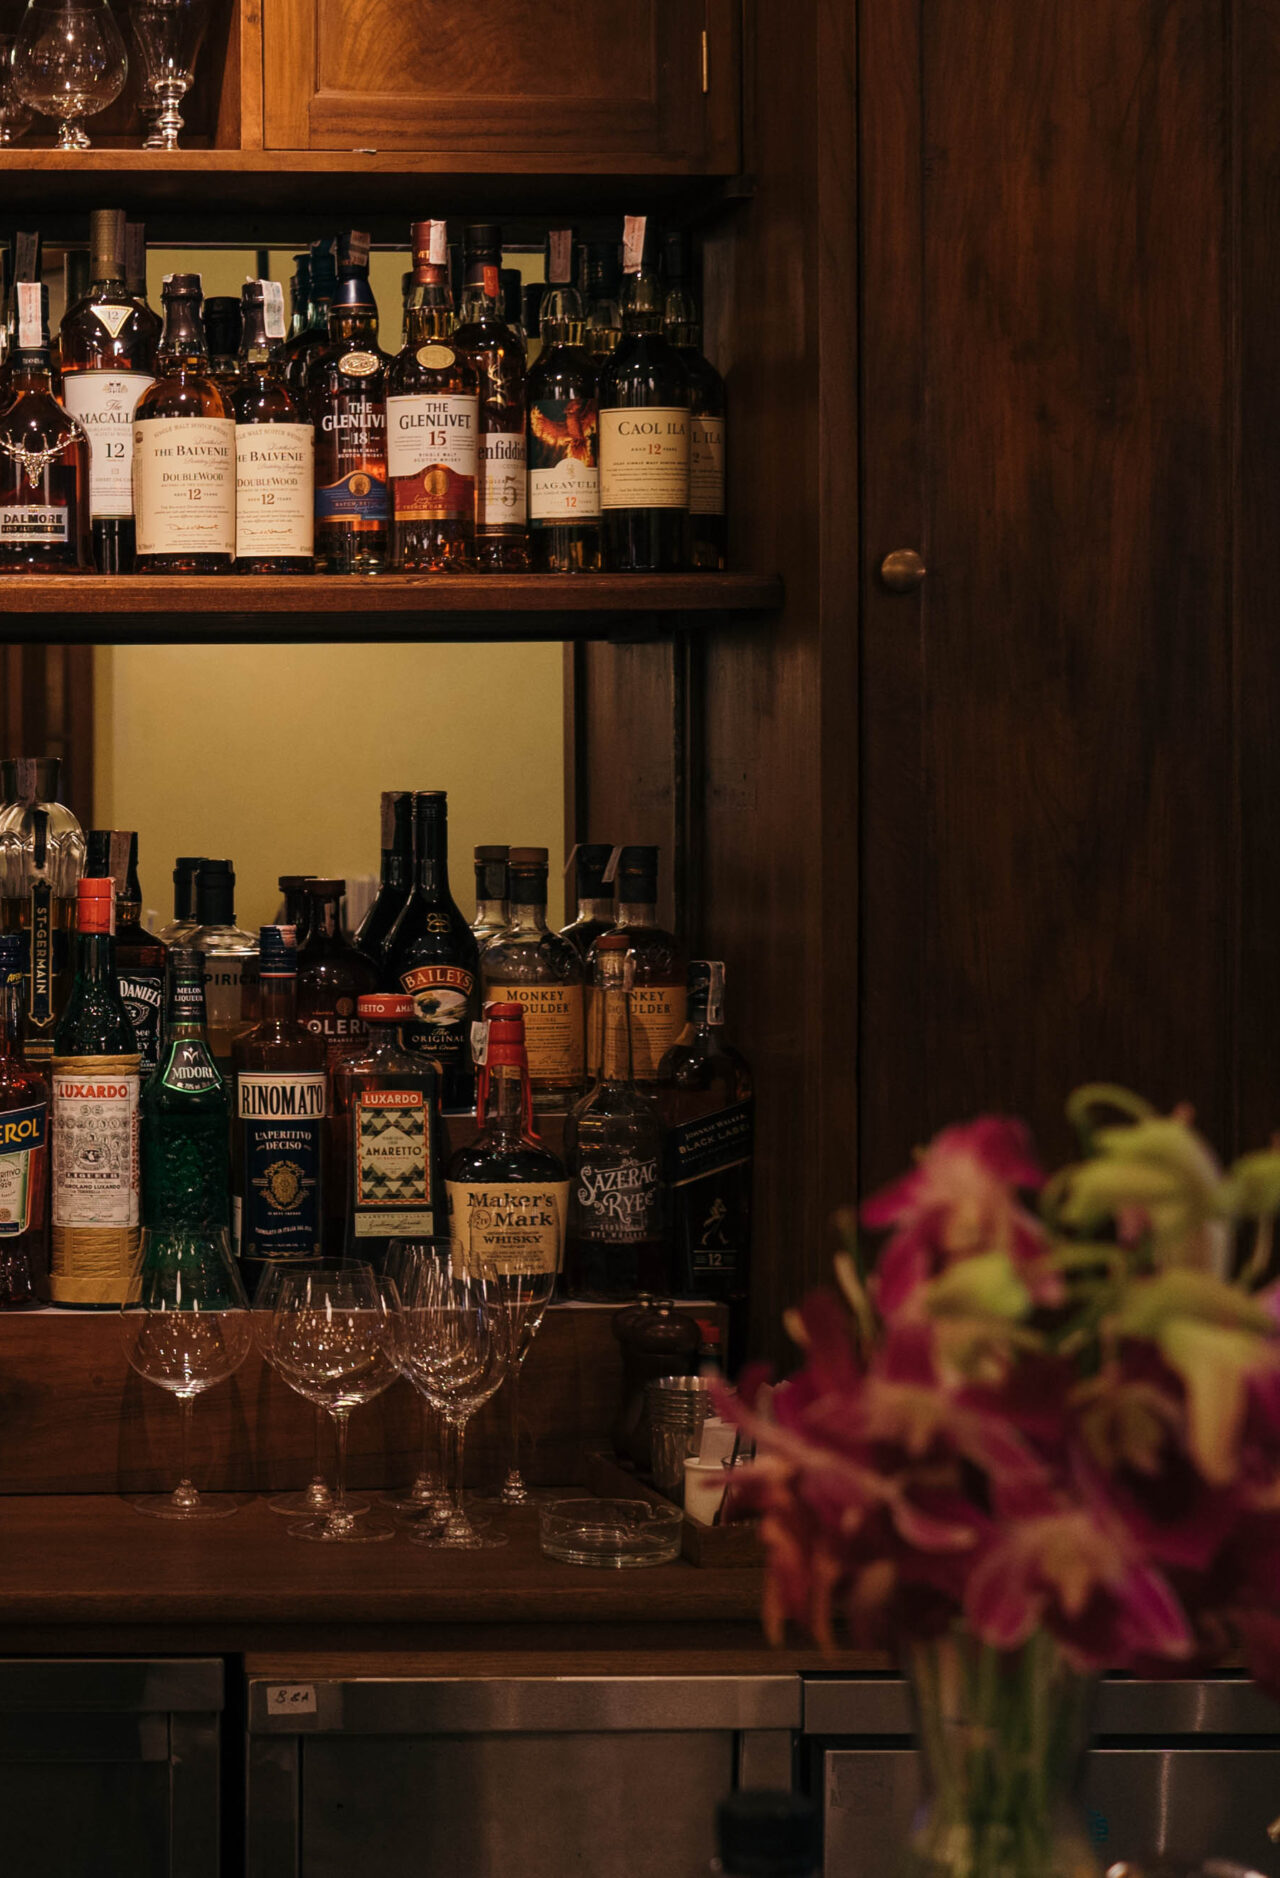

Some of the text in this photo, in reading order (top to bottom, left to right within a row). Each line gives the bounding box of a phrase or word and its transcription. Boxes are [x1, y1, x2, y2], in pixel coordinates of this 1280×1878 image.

[348, 402, 373, 414] THE
[426, 402, 449, 412] THE
[78, 412, 133, 424] MACALL
[322, 415, 384, 431] GLENLIV
[399, 414, 472, 430] GLENLIVET
[618, 421, 686, 436] CAOL ILA
[352, 431, 368, 445] 18
[428, 430, 447, 446] 15
[105, 443, 125, 459] 12
[154, 445, 229, 457] THE BALVENIE
[648, 443, 662, 456] 12
[237, 451, 304, 462] HE BALVENIE
[535, 481, 598, 491] LAGAVULI
[188, 488, 202, 500] 12
[261, 493, 275, 505] 12
[565, 496, 577, 508] 12
[3, 513, 63, 524] DALMORE
[36, 906, 48, 995] ST-GERMAIN
[404, 968, 472, 989] BAILEYS
[174, 994, 203, 1002] LIQUEUR
[506, 990, 565, 1001] MONKEY
[630, 991, 665, 1001] NKEY
[522, 1003, 569, 1014] OULDER
[630, 1004, 670, 1014] ULDER
[307, 1018, 368, 1035] OLERN
[411, 1035, 465, 1043] ORIGINAL
[172, 1066, 215, 1080] MIDORI
[59, 1084, 128, 1098] LUXARDO
[241, 1084, 323, 1115] RINOMATO
[365, 1094, 419, 1104] LUXARDO
[255, 1130, 312, 1141] L'APERITIVO
[265, 1140, 302, 1151] DECISO
[677, 1134, 715, 1154] BLACK
[365, 1146, 422, 1156] AMARETTO
[578, 1162, 657, 1206] SAZERAC
[466, 1192, 553, 1208] Maker's
[602, 1191, 646, 1224] RYE
[493, 1212, 553, 1227] Mark
[482, 1234, 544, 1244] WHISKY
[707, 1253, 722, 1266] 12
